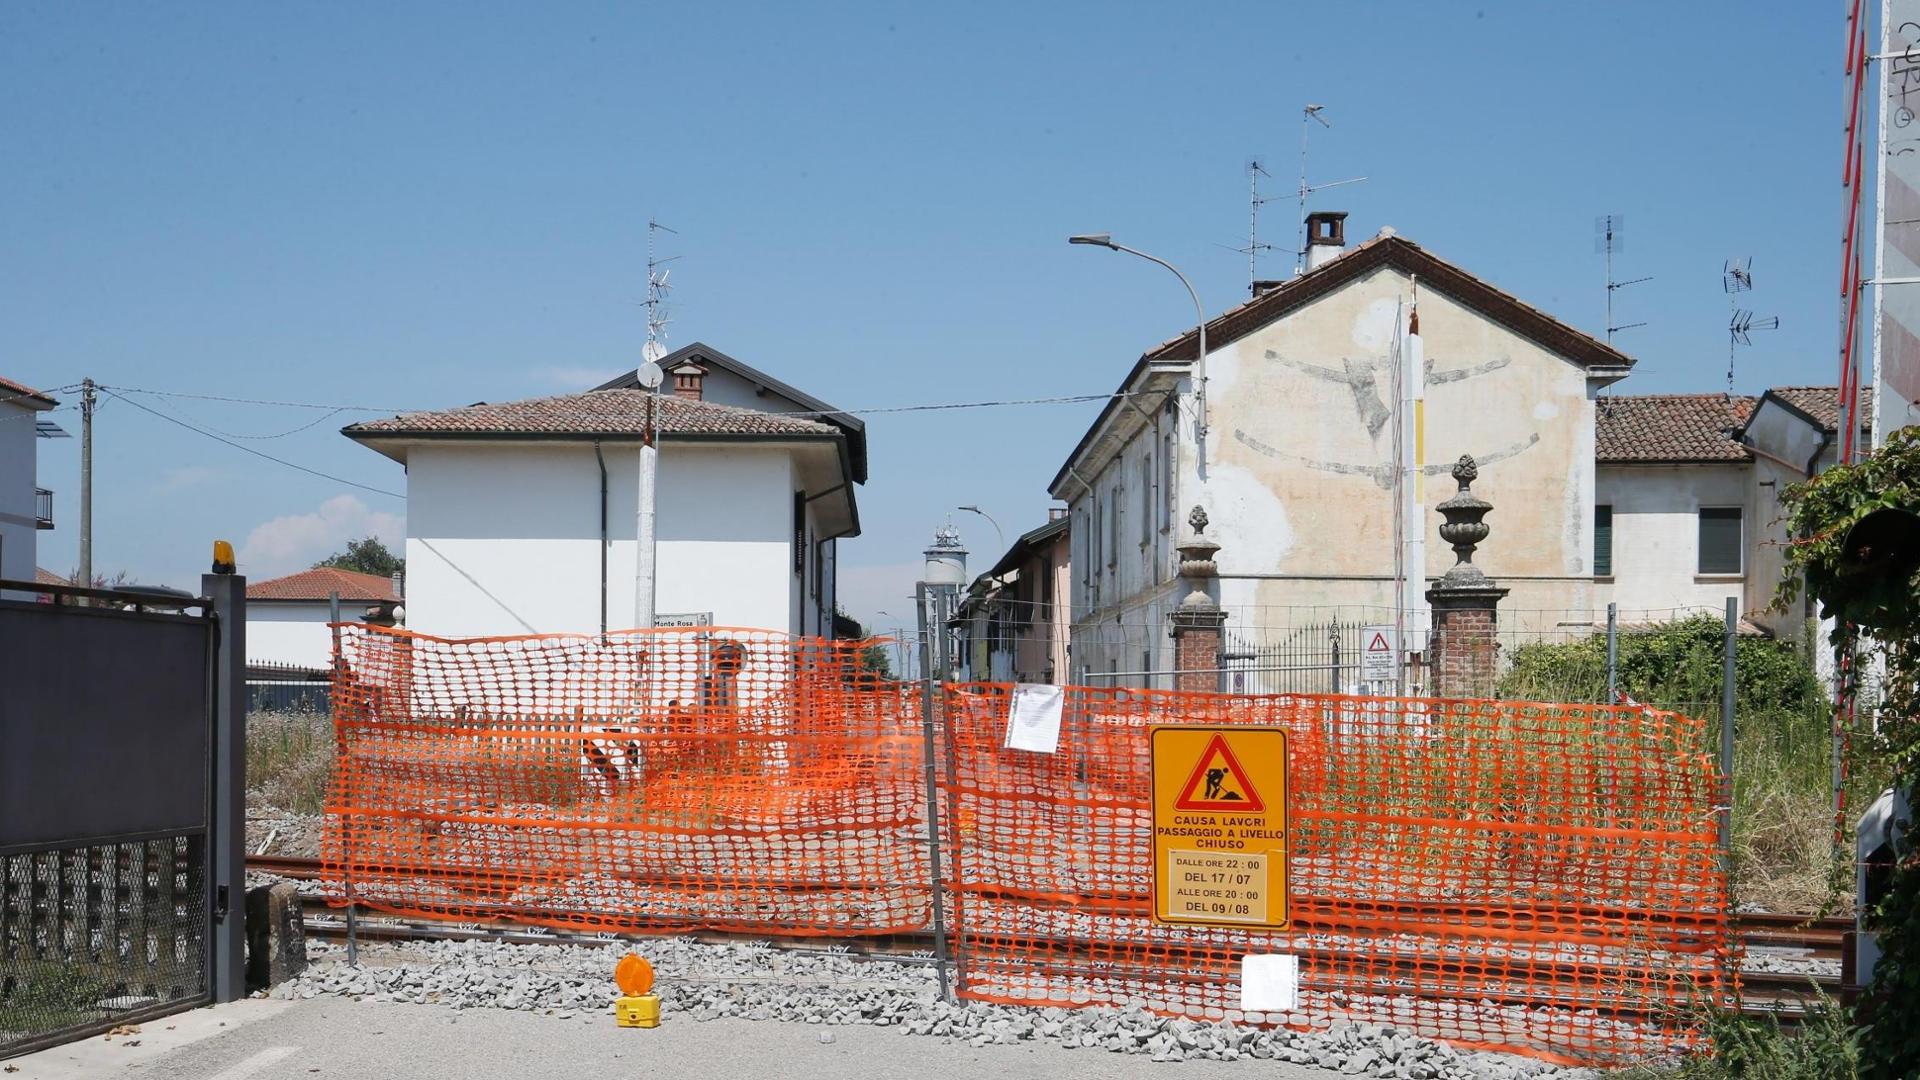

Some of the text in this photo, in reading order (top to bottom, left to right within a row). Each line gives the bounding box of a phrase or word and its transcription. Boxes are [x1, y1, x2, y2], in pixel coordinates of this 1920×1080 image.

[1174, 816, 1266, 827] CAUSA LAVORI
[1157, 827, 1284, 840] PASSAGGIO A LIVELLO
[1196, 839, 1245, 849] CHIUSO
[1176, 858, 1203, 867] DALLE
[1205, 860, 1224, 868] ORE
[1184, 872, 1208, 883] DEL
[1211, 873, 1225, 884] 17
[1236, 874, 1251, 885] 07
[1177, 888, 1201, 897] ALLE
[1203, 889, 1222, 898] ORE
[1185, 902, 1208, 912] DEL
[1211, 903, 1225, 914] 09
[1235, 904, 1250, 915] 08
